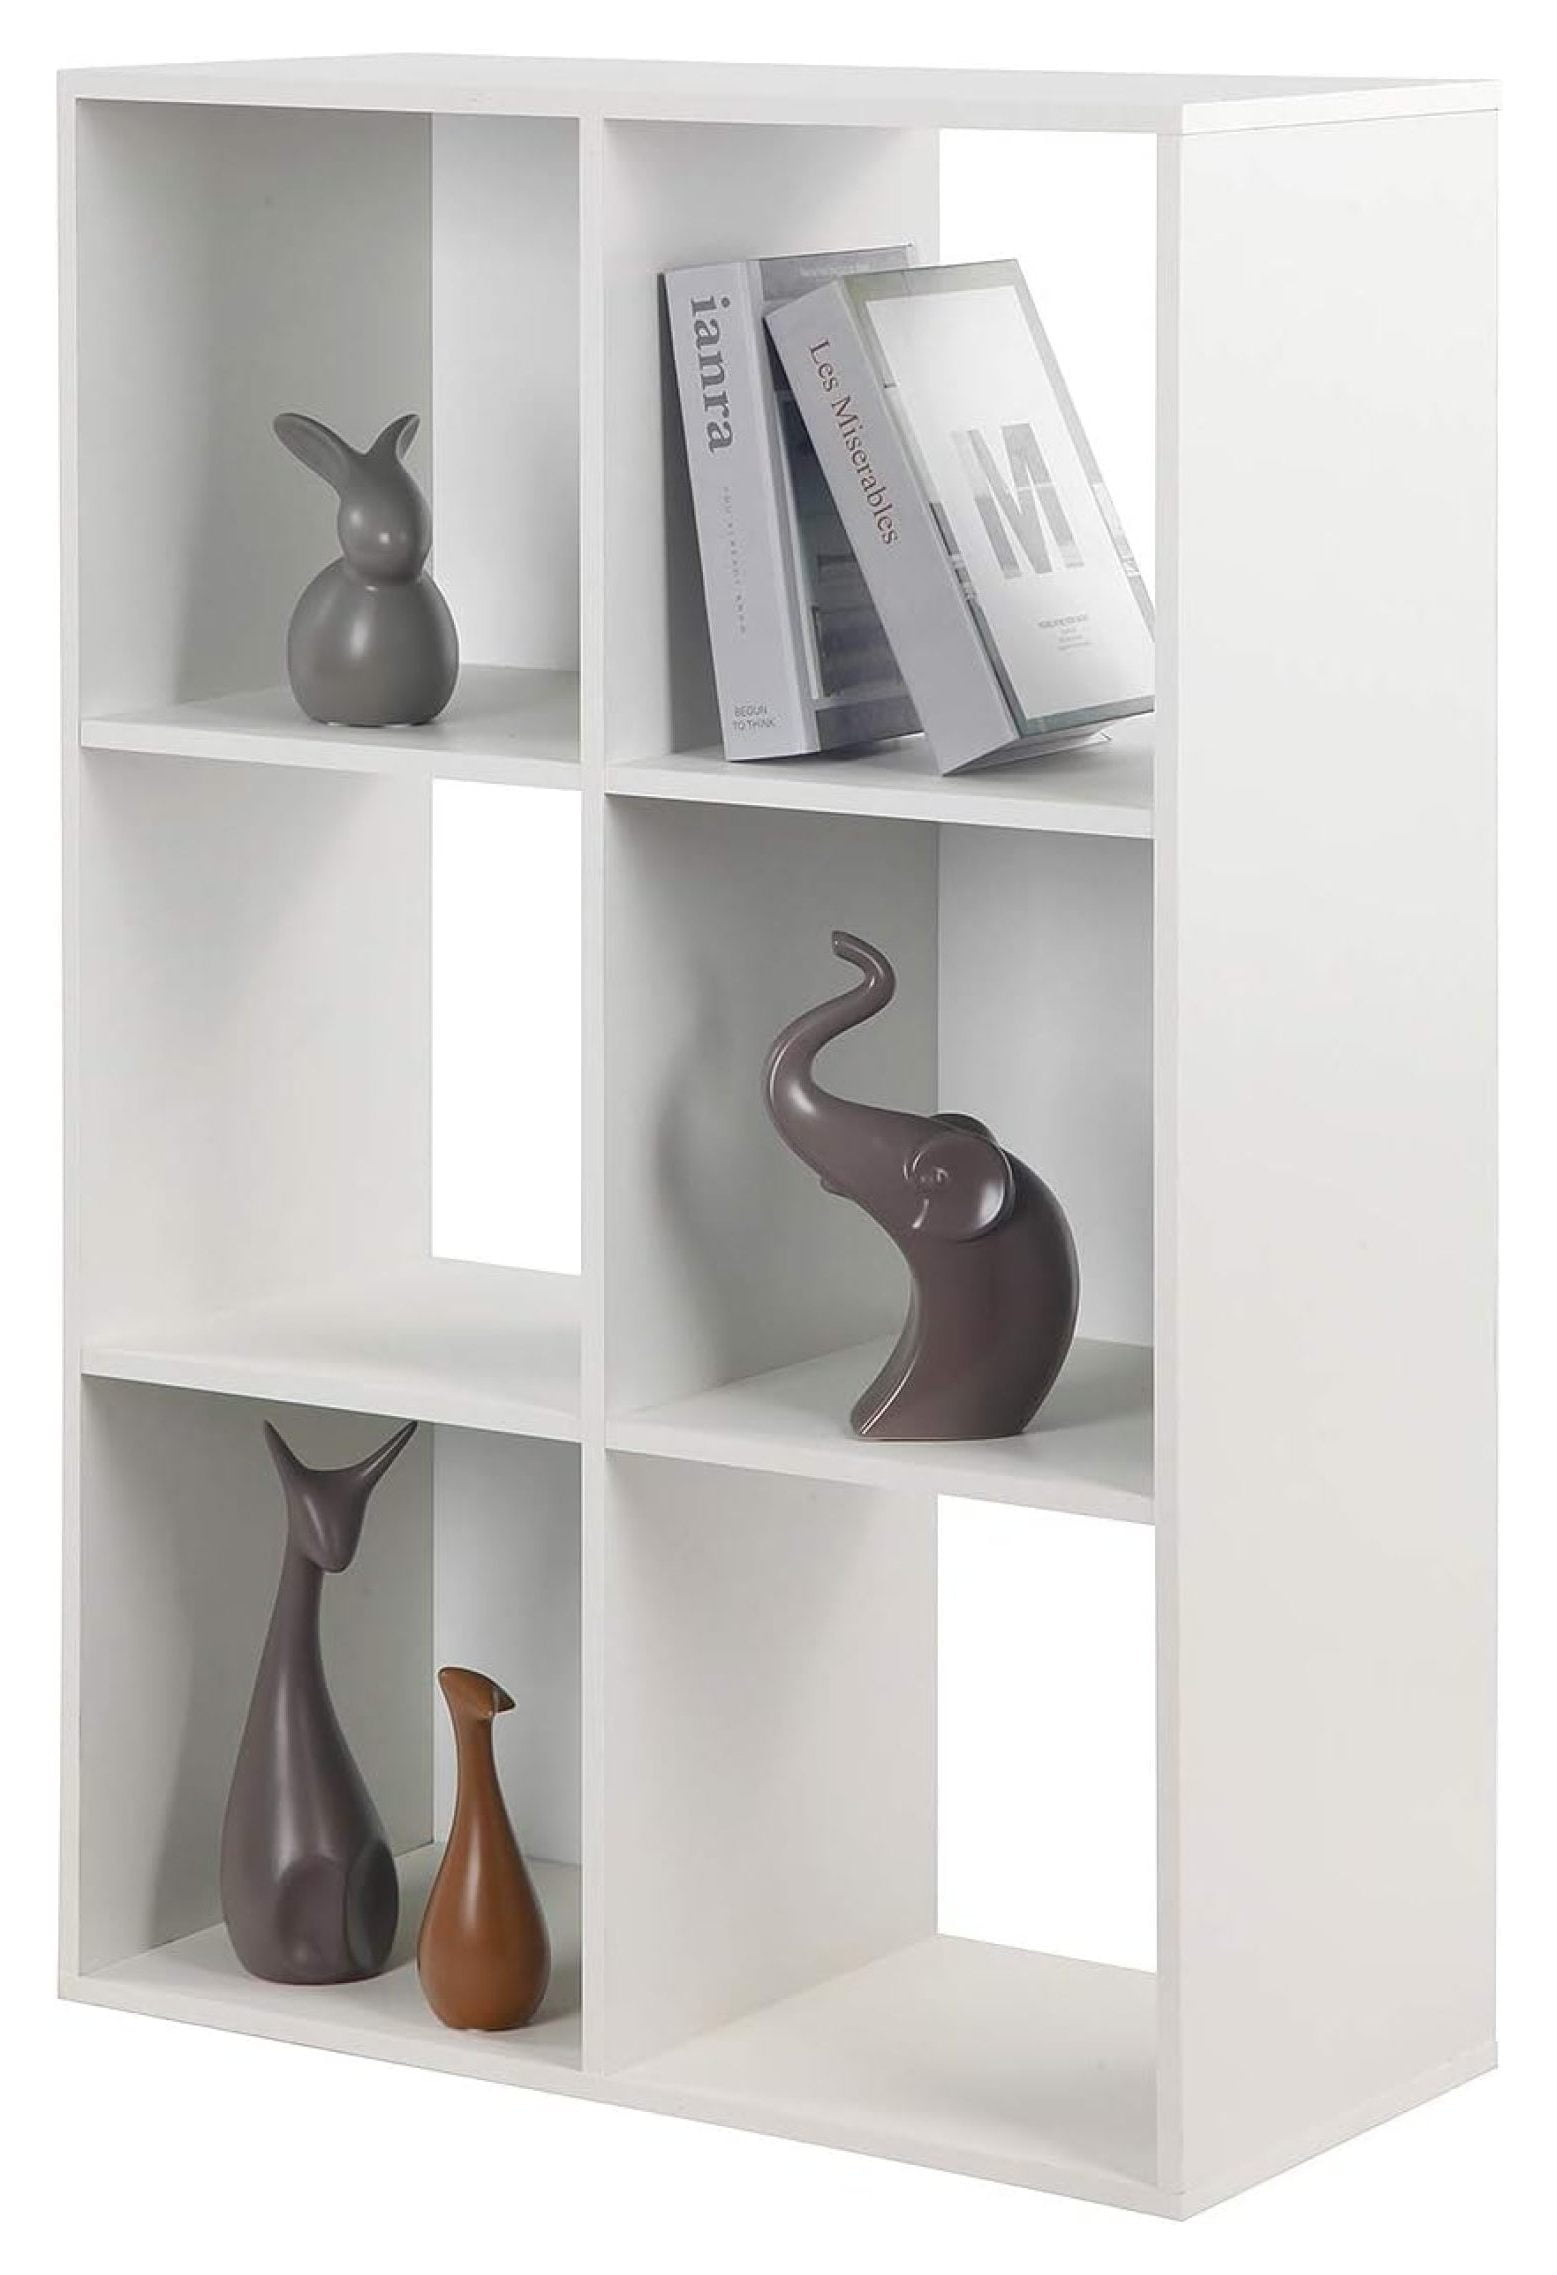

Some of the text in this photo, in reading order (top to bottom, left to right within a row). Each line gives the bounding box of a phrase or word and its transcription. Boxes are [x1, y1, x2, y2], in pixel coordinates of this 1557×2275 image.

[691, 296, 734, 453] ianra
[809, 338, 899, 545] Les Miserables
